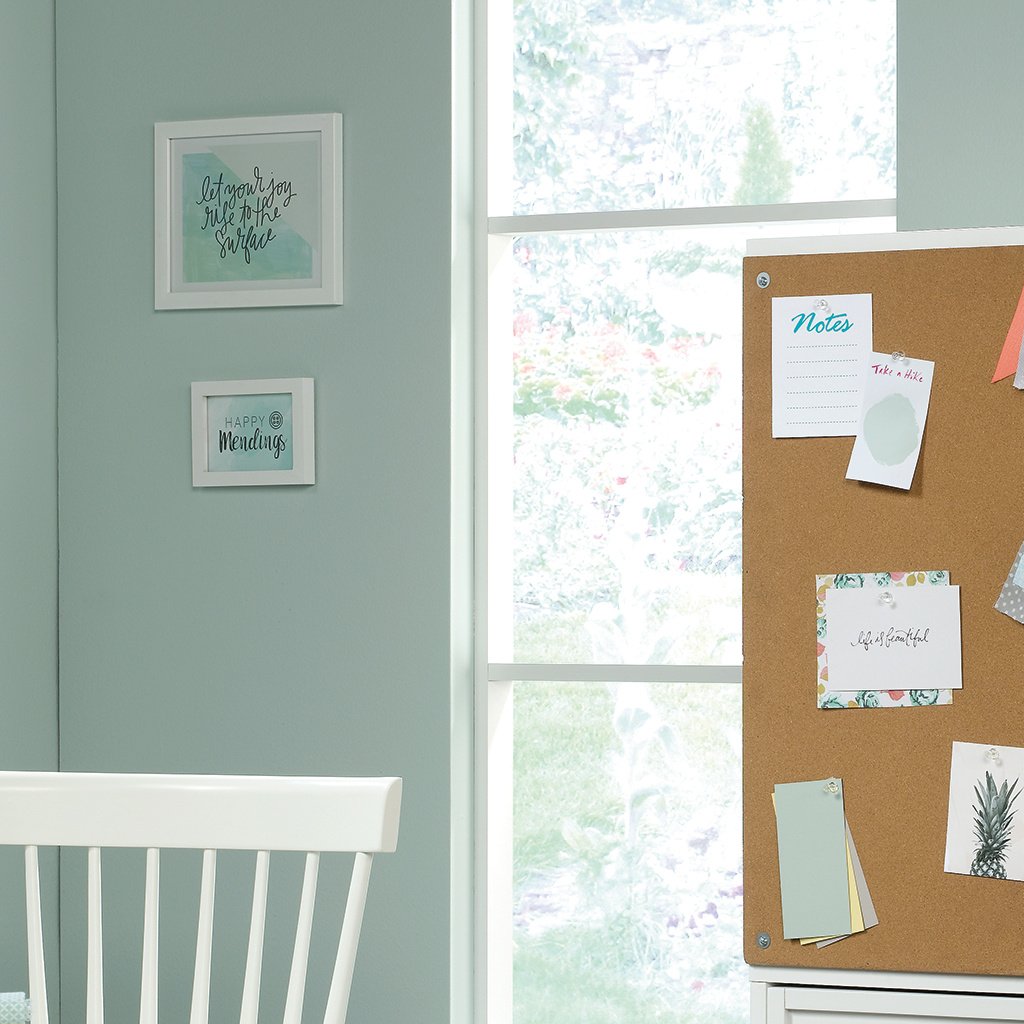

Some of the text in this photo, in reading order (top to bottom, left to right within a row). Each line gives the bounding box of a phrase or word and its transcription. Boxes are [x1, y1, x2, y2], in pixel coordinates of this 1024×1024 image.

[196, 166, 297, 208] let your joy
[201, 196, 281, 236] rise to the
[791, 312, 854, 334] Notes
[872, 364, 893, 376] Take
[904, 370, 924, 383] Hike
[225, 415, 265, 428] HAPPY
[219, 427, 287, 459] Mendings
[850, 626, 930, 651] life is beautiful
